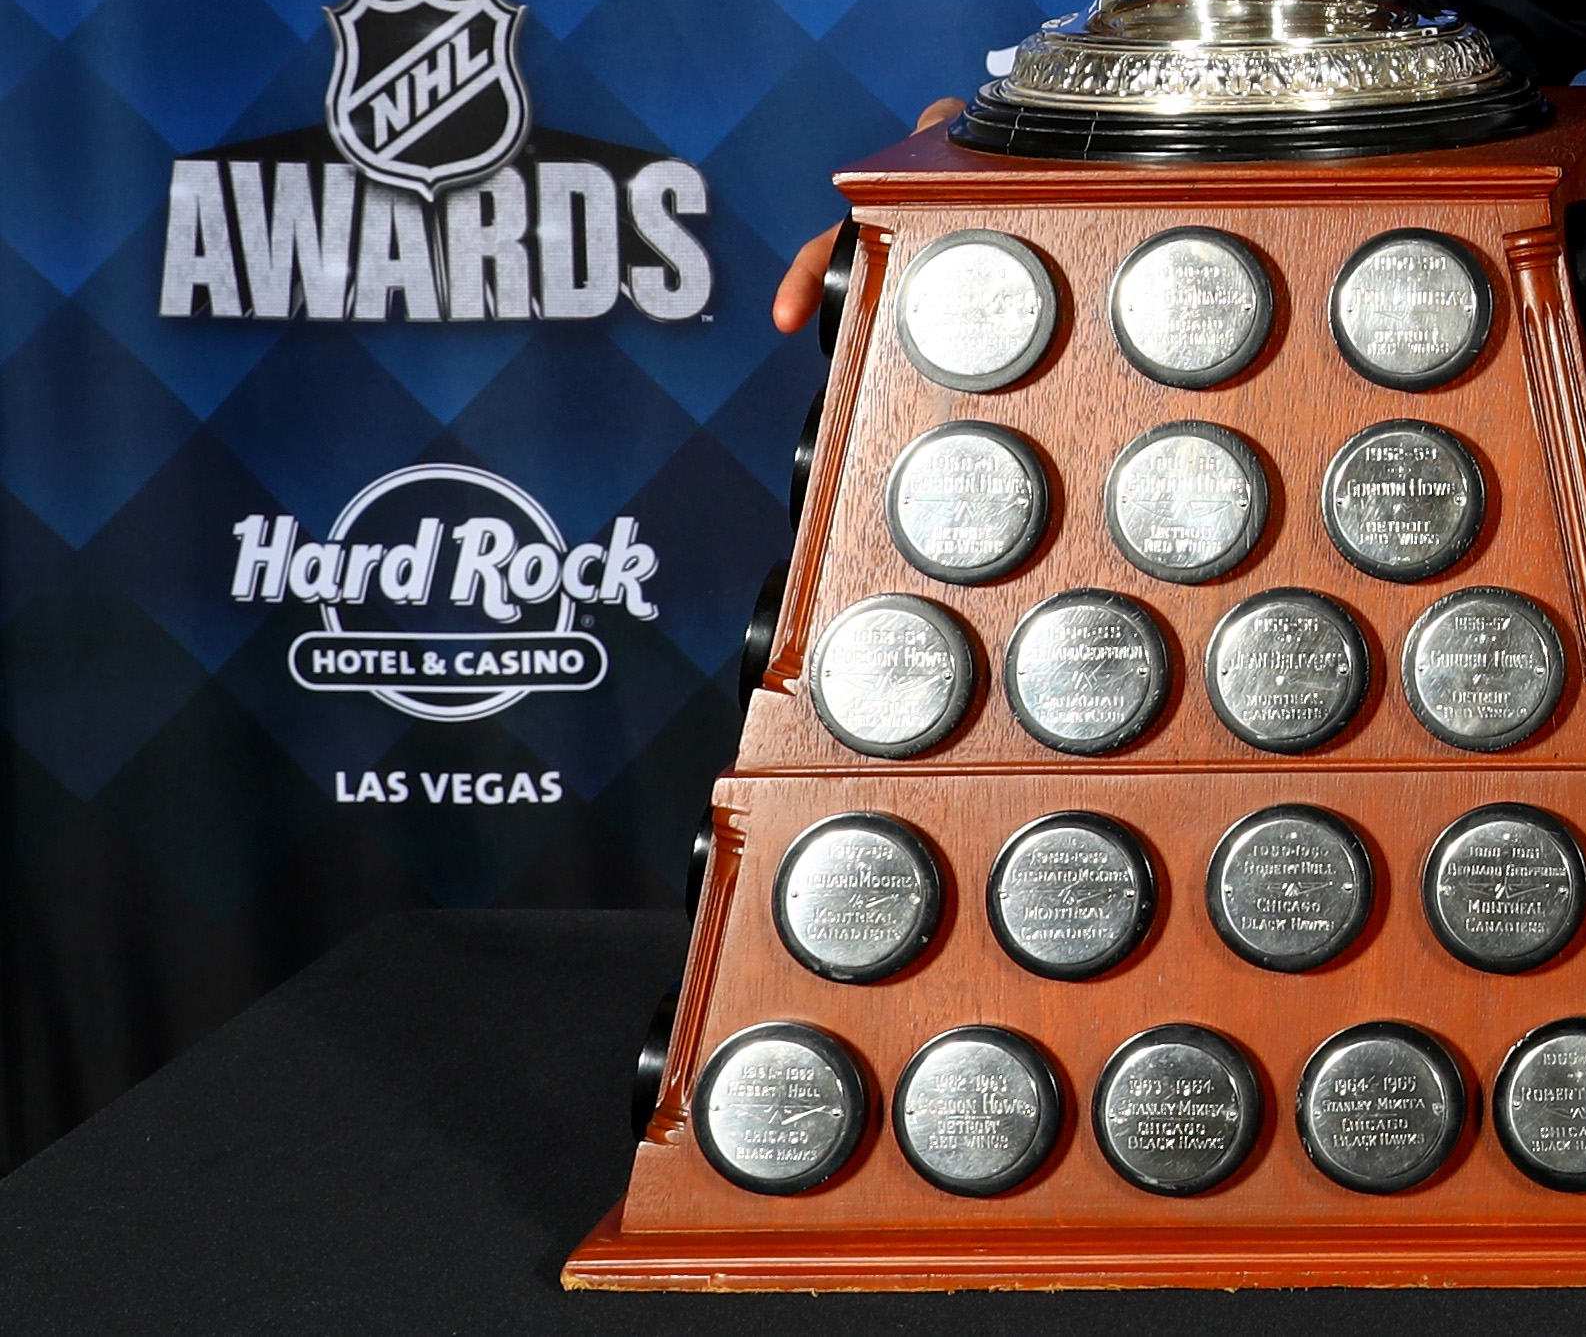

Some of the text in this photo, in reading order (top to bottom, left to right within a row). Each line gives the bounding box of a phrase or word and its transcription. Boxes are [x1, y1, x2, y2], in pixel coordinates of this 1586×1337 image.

[370, 28, 488, 146] NHL
[159, 158, 714, 323] AWARDS
[232, 515, 659, 622] Hard Rock
[313, 649, 584, 676] HOTEL & CASINO
[337, 771, 563, 804] LAS VEGAS
